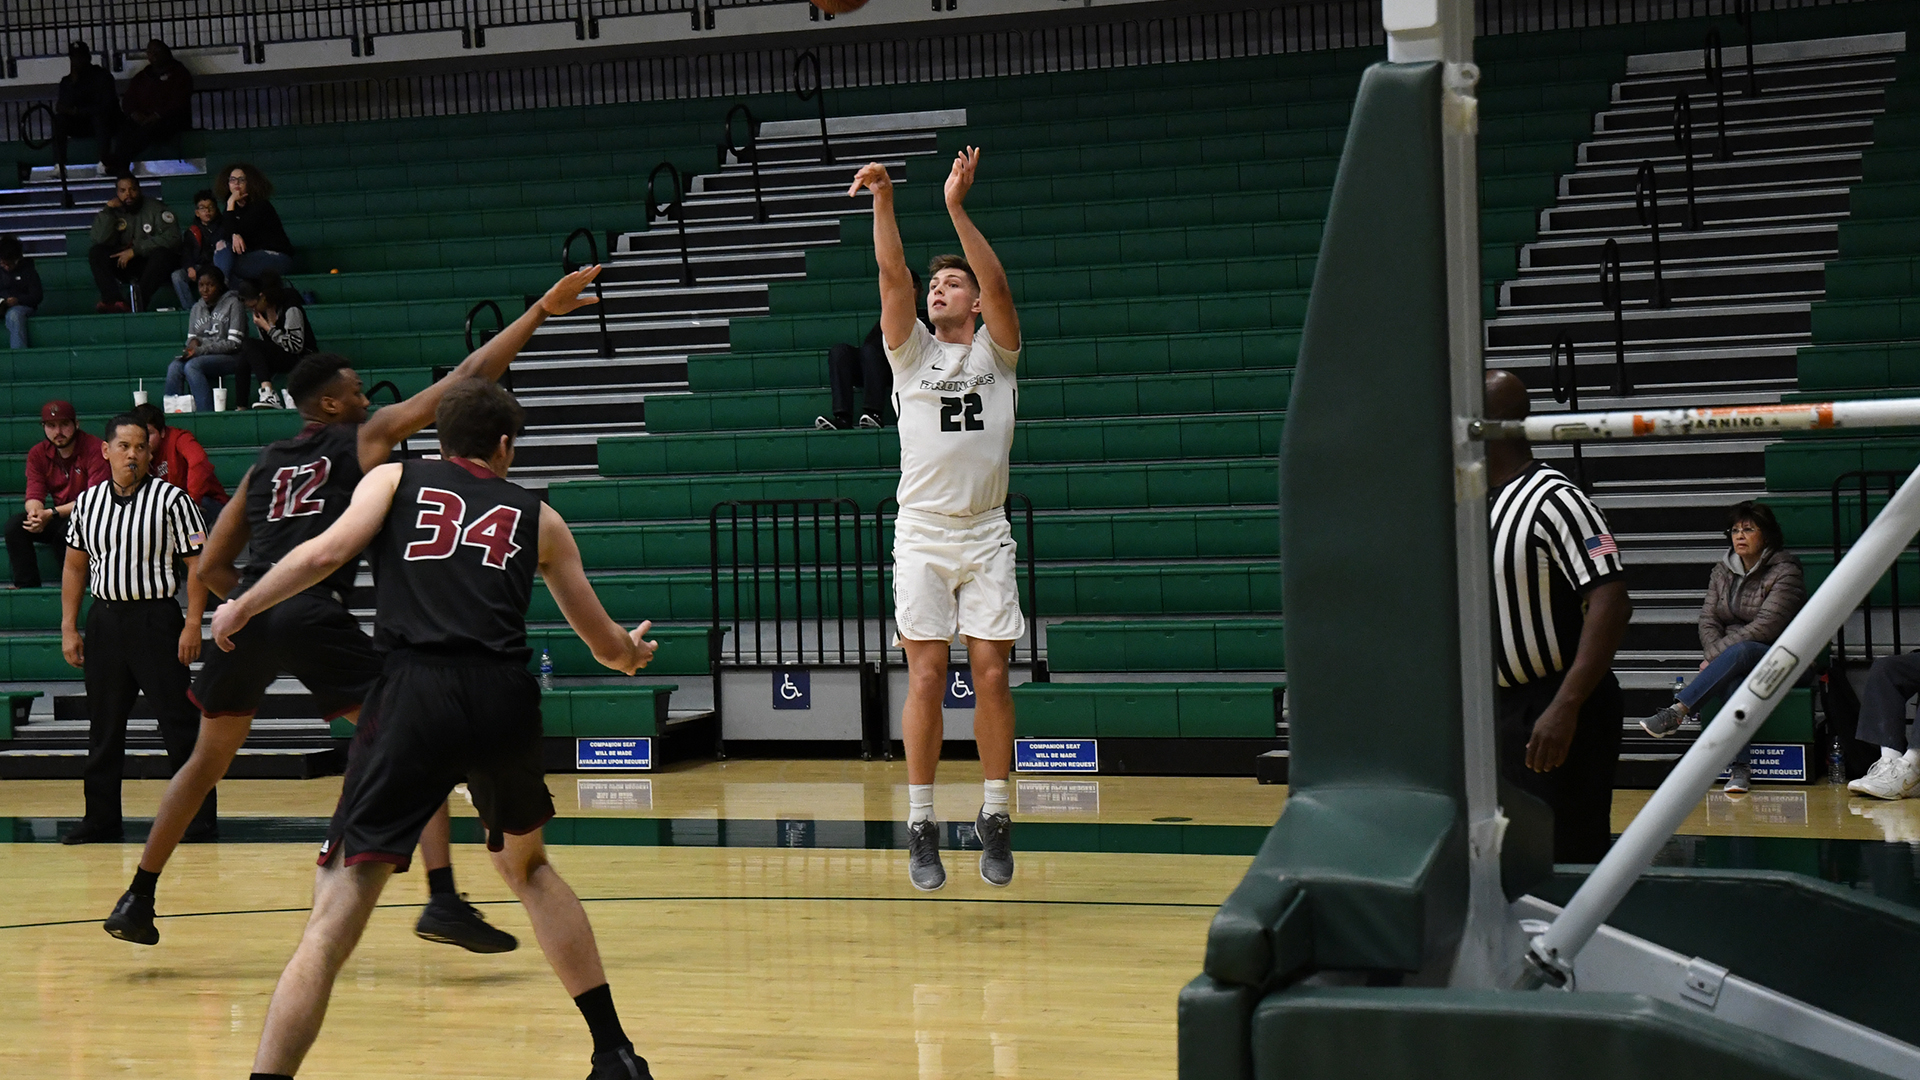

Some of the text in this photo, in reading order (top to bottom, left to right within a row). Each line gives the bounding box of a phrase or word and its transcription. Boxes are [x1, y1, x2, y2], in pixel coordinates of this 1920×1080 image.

[919, 373, 995, 392] BRONCOS
[940, 392, 985, 432] 22
[267, 455, 332, 522] 12
[403, 487, 523, 571] 34
